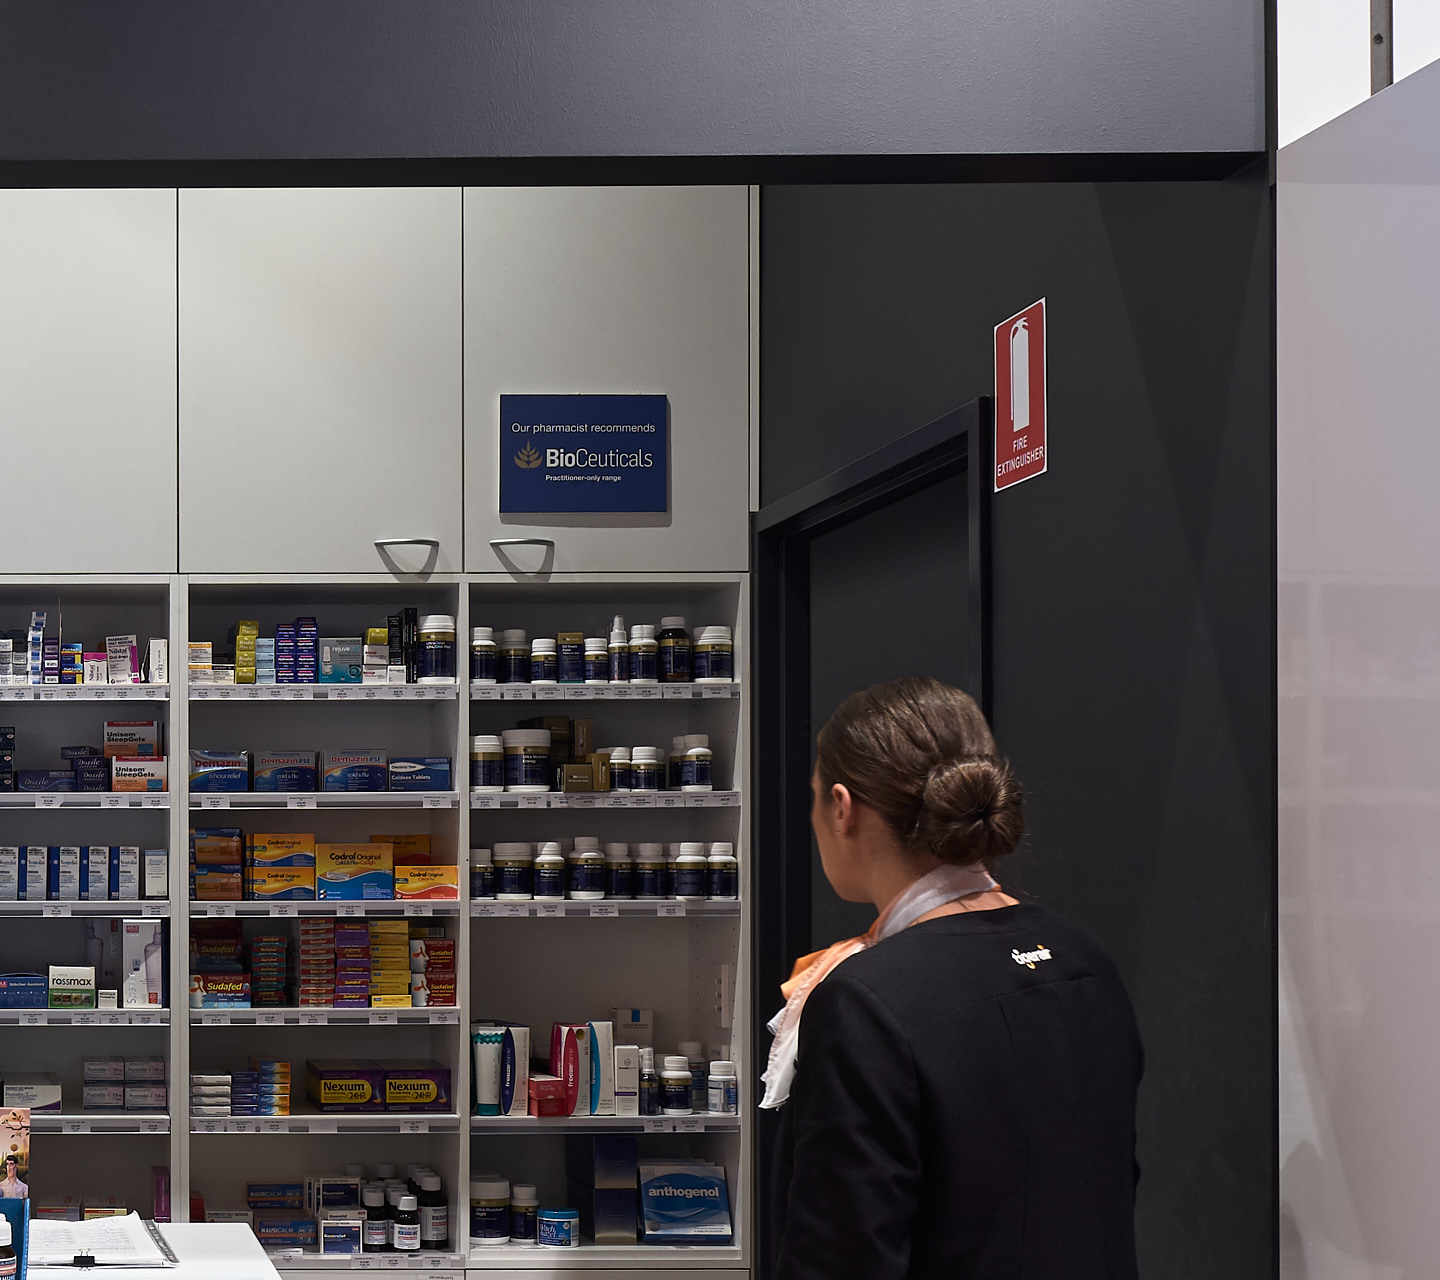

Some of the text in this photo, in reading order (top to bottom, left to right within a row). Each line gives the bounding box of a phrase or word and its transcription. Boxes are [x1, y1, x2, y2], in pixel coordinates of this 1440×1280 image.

[511, 423, 656, 435] Our pharmacist recommends
[1013, 435, 1028, 452] FIRE
[546, 448, 653, 468] BioCeuticals
[997, 446, 1044, 477] EXTINGUISHER
[195, 759, 241, 768] Demazin
[52, 978, 92, 986] rossmax
[207, 983, 242, 991] Sudafed
[323, 1082, 364, 1091] Nexium
[649, 1187, 719, 1198] anthogenol
